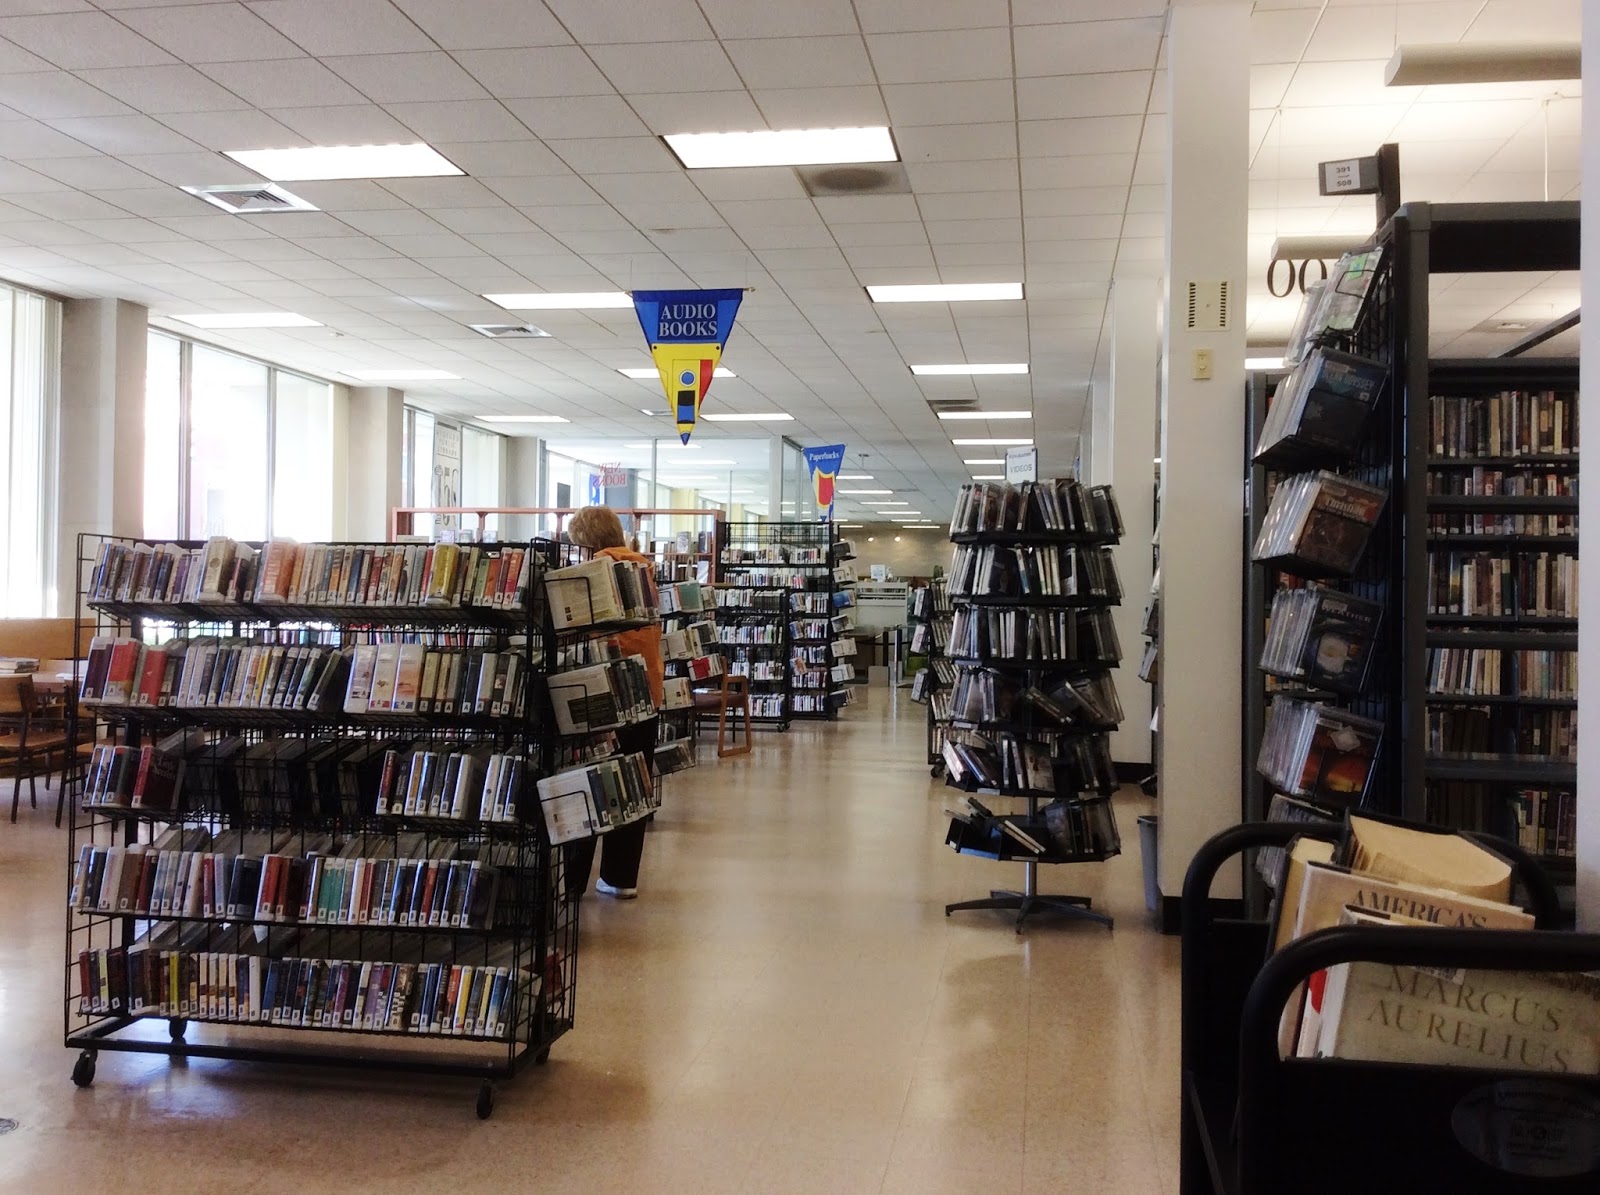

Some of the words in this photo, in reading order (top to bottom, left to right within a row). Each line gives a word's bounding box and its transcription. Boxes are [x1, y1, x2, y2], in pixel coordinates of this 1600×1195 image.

[660, 303, 716, 320] AUDIO
[659, 320, 718, 337] BOOKS
[1010, 464, 1033, 473] VIDEOS
[1352, 889, 1487, 928] AMERICA'S
[1387, 965, 1562, 1032] MARCUS
[1367, 999, 1571, 1072] AURELIUS
